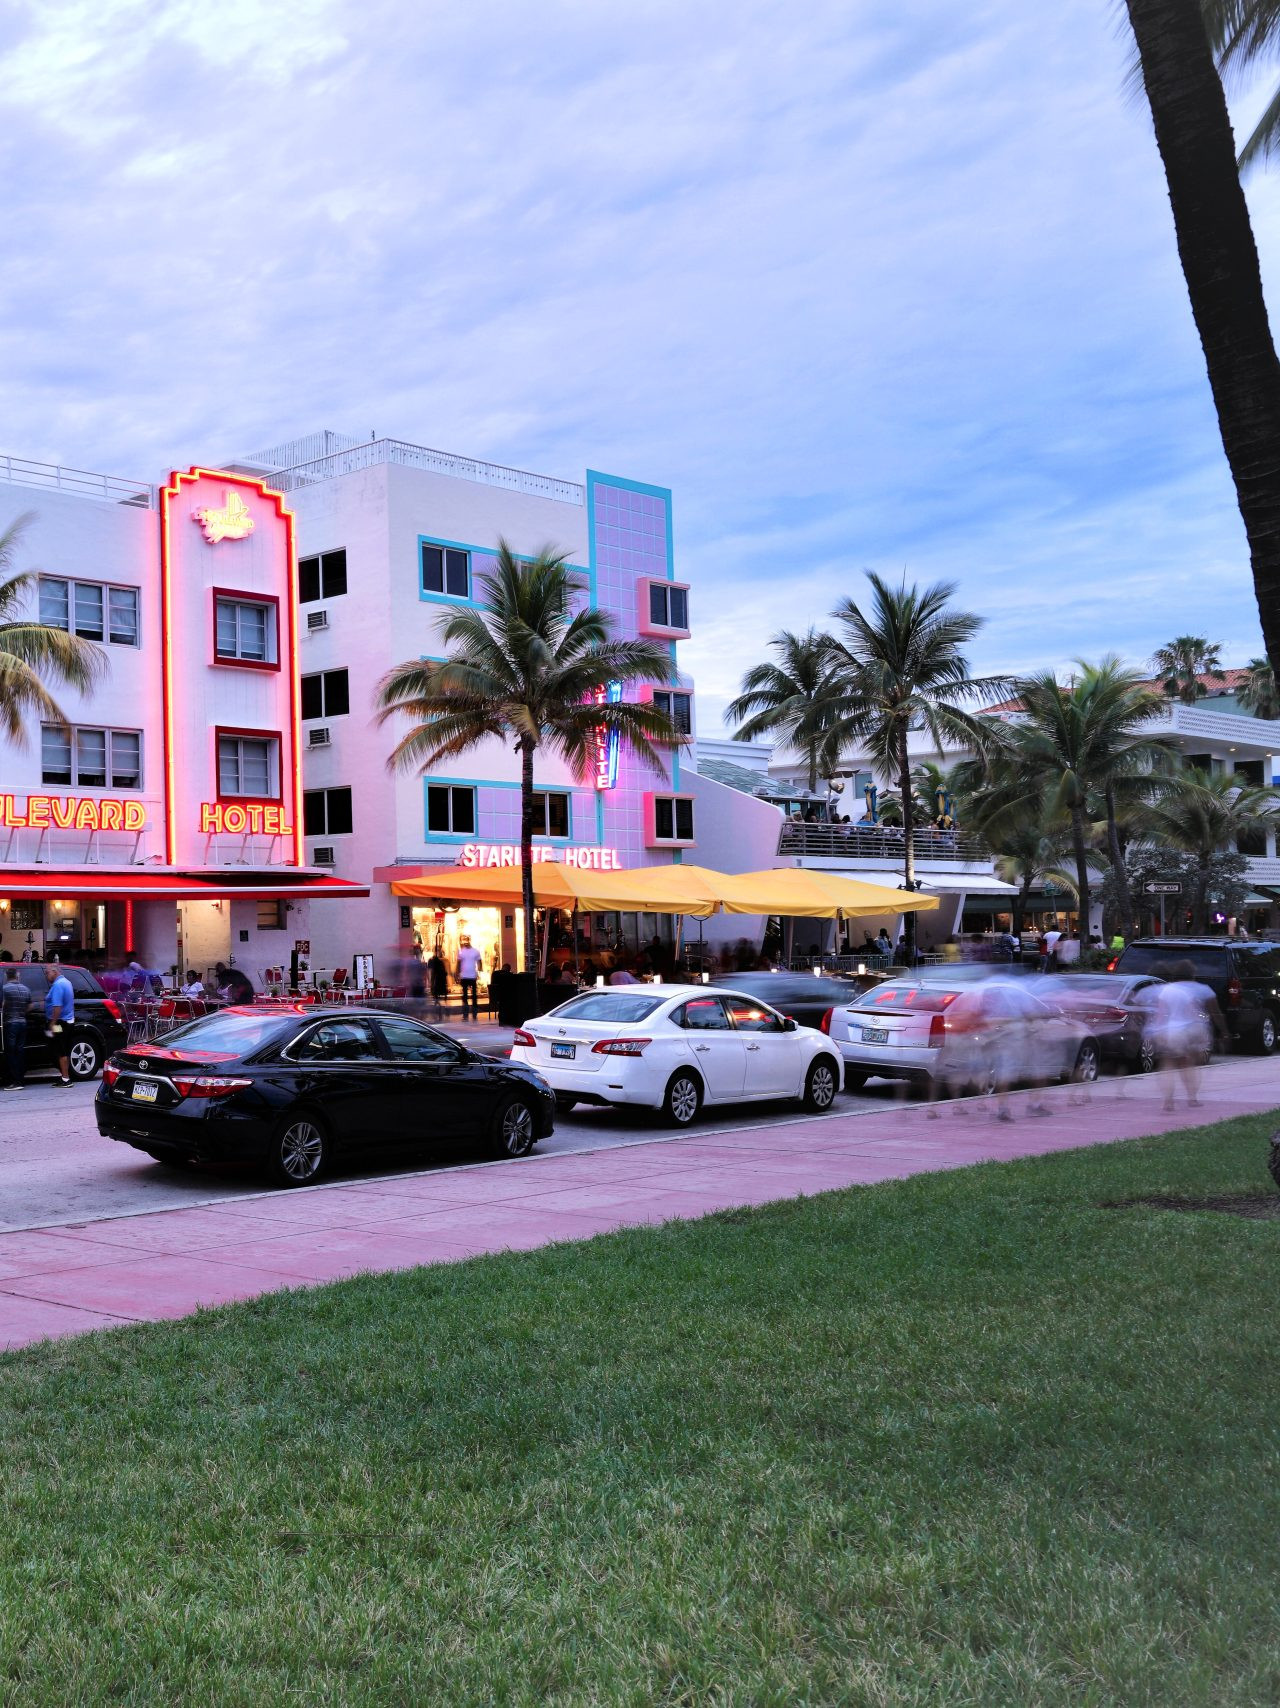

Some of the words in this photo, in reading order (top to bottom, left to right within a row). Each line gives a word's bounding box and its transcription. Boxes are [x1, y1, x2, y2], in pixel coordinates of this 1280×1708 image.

[201, 801, 294, 835] HOTEL
[463, 844, 553, 868] STARLTE
[565, 847, 623, 869] HOTEL
[297, 943, 308, 951] FDC
